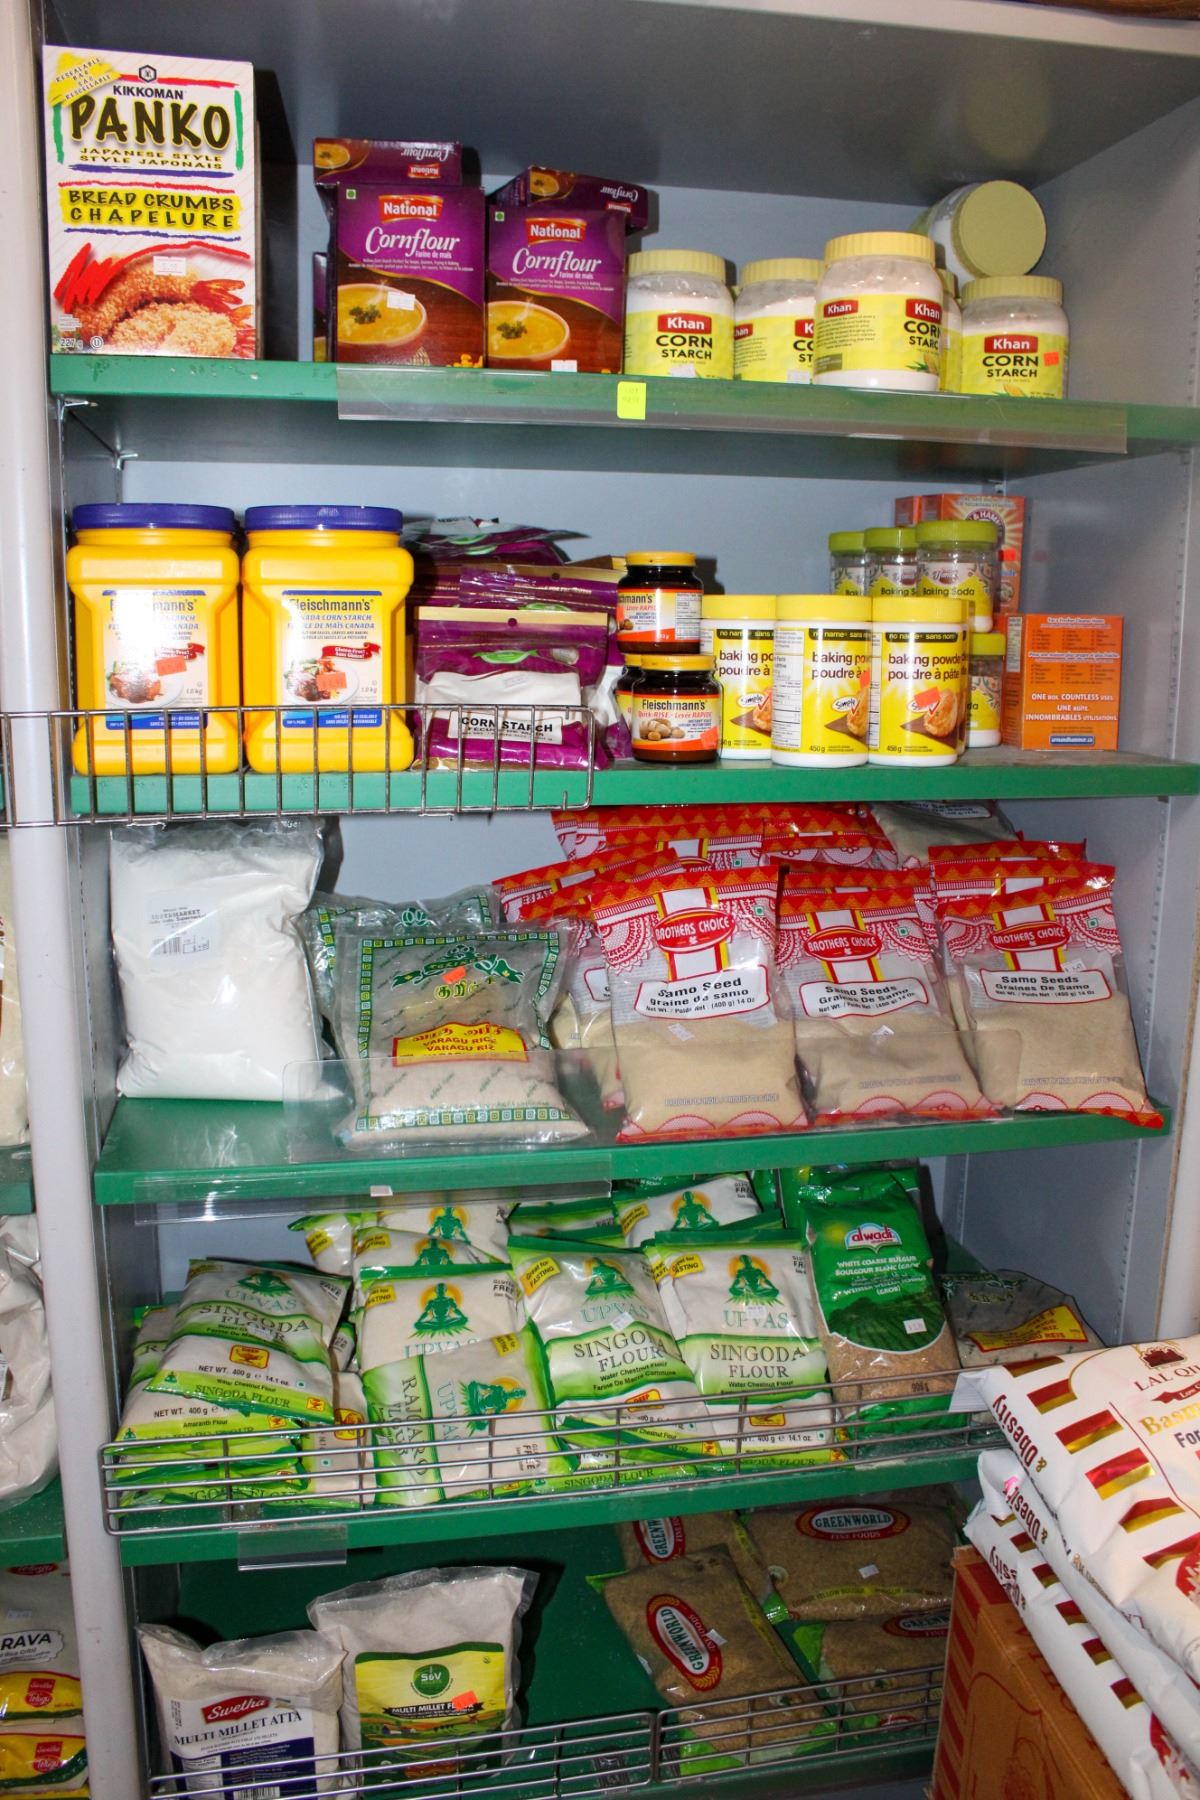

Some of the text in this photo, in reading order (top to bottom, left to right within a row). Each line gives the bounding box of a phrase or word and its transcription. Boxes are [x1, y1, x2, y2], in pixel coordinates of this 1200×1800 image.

[113, 85, 184, 100] KIKKOMAN
[71, 93, 232, 149] PANKO
[80, 147, 223, 162] JAPANESE STYLE
[80, 155, 223, 169] STYLE JAPONAIS
[68, 189, 235, 211] BREAD CRUMBS
[383, 200, 438, 216] National
[70, 207, 233, 228] CHAPELURE
[530, 222, 581, 239] National
[365, 226, 461, 257] Cornflour
[512, 247, 602, 278] Cornflour
[827, 303, 852, 314] Khan
[914, 303, 940, 320] Khan
[667, 317, 705, 330] Khan
[656, 335, 713, 349] CORN
[909, 335, 939, 350] STARC
[993, 338, 1031, 350] Khan
[661, 348, 712, 361] STARCH
[982, 355, 1039, 367] CORN
[987, 368, 1038, 378] STARCH
[922, 587, 975, 597] Baking Soda
[812, 651, 853, 666] baking
[888, 653, 930, 667] bakng
[811, 668, 854, 681] poudre
[934, 667, 941, 680] à
[642, 698, 706, 711] Fleischmann's
[461, 716, 496, 728] CORN
[655, 916, 730, 940] BROTHERS CHOICE
[993, 927, 1065, 944] BROTHERS CHOICE
[807, 936, 877, 952] BROTHERS CHOICE
[995, 983, 1037, 991] Graines
[1001, 975, 1079, 984] Samo Seeds
[658, 977, 742, 999] Samo Seed
[860, 985, 897, 995] Seeds
[650, 994, 689, 1006] graine
[713, 989, 749, 1000] samo
[423, 1037, 468, 1046] VARAGU
[675, 1262, 699, 1274] ASTING
[200, 1304, 310, 1334] SINGODA
[573, 1329, 668, 1358] SINGOA
[598, 1346, 665, 1372] FLOUR
[710, 1343, 807, 1363] SINGODA
[198, 1364, 214, 1373] NET
[215, 1366, 228, 1374] WT.
[600, 1370, 618, 1382] Water
[729, 1365, 790, 1378] FLOUR
[1134, 1373, 1174, 1391] LAL
[194, 1384, 291, 1409] SINGODA FLOUR
[153, 1406, 208, 1418] NET WT. 400 g
[992, 1394, 1038, 1467] Obesity
[1174, 1429, 1200, 1448] For
[564, 1467, 655, 1487] SINGODA FLOUR
[815, 1514, 892, 1528] GREENWORLD
[1, 1633, 52, 1650] RAVA
[660, 1608, 705, 1671] GREENWORLD
[207, 1697, 266, 1720] Swetha
[391, 1703, 445, 1714] MULTI MILLET
[174, 1731, 215, 1746] MULTI
[219, 1716, 268, 1737] MILLET
[270, 1710, 303, 1726] ATTA
